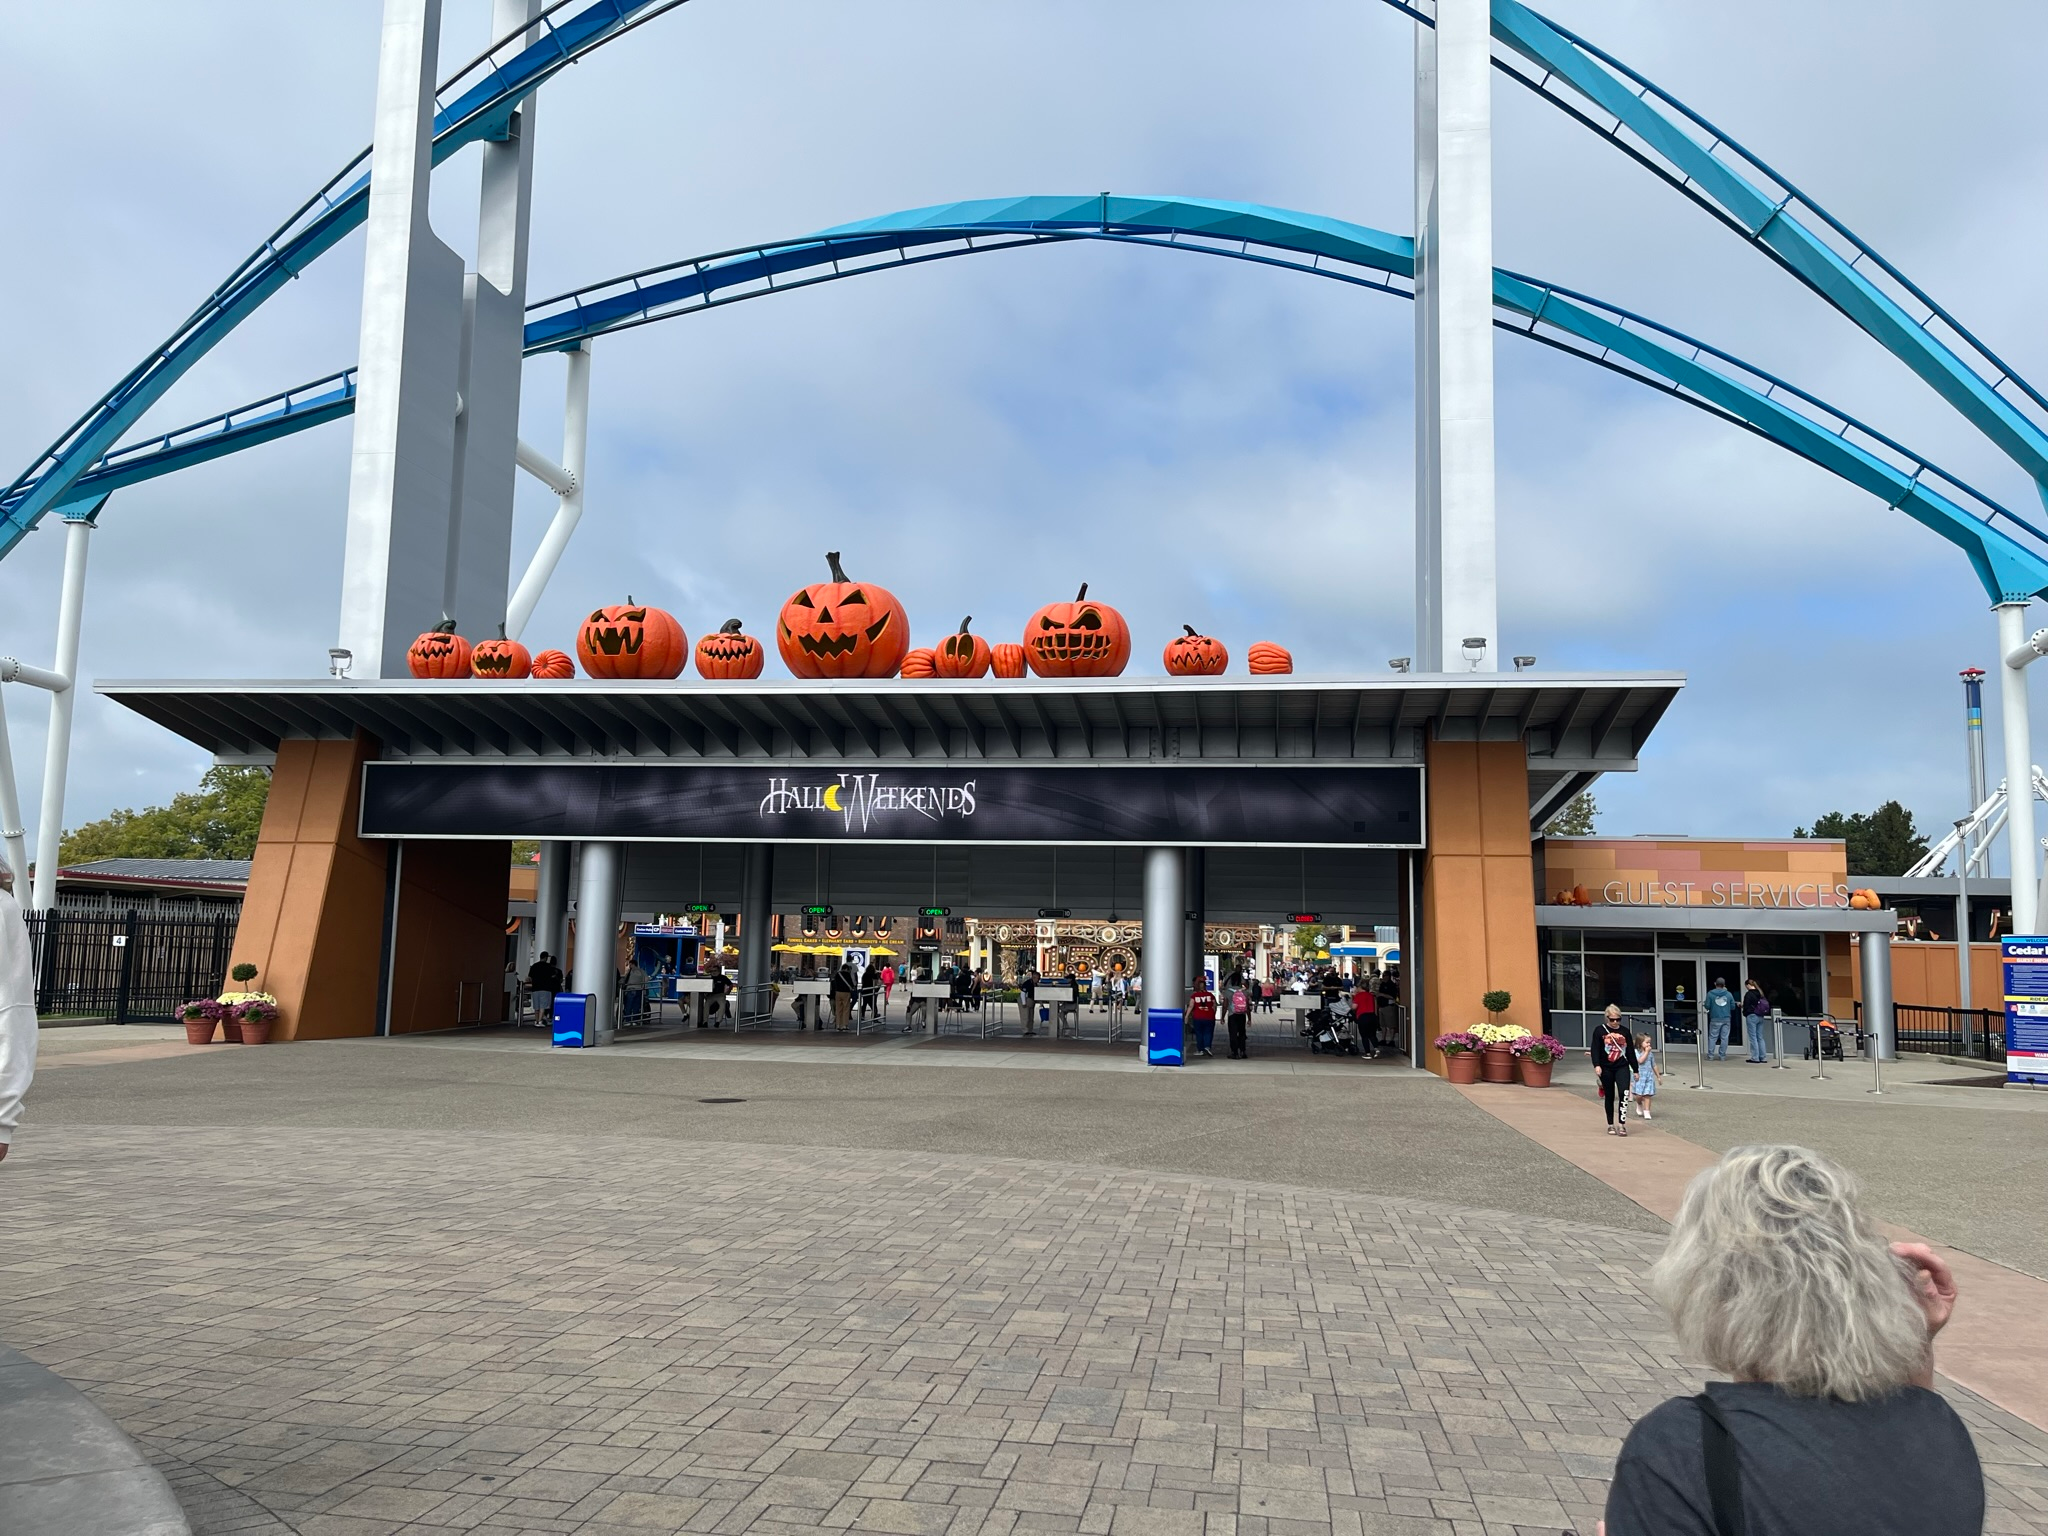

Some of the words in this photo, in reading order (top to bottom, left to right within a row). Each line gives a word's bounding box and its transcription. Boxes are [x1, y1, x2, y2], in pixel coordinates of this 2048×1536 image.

[1603, 880, 1695, 905] GUEST
[1711, 881, 1850, 908] SERVICES
[1043, 945, 1137, 979] 150
[2008, 945, 2044, 955] Cedar
[1194, 995, 1212, 1003] BYE
[1620, 1089, 1629, 1122] adidas
